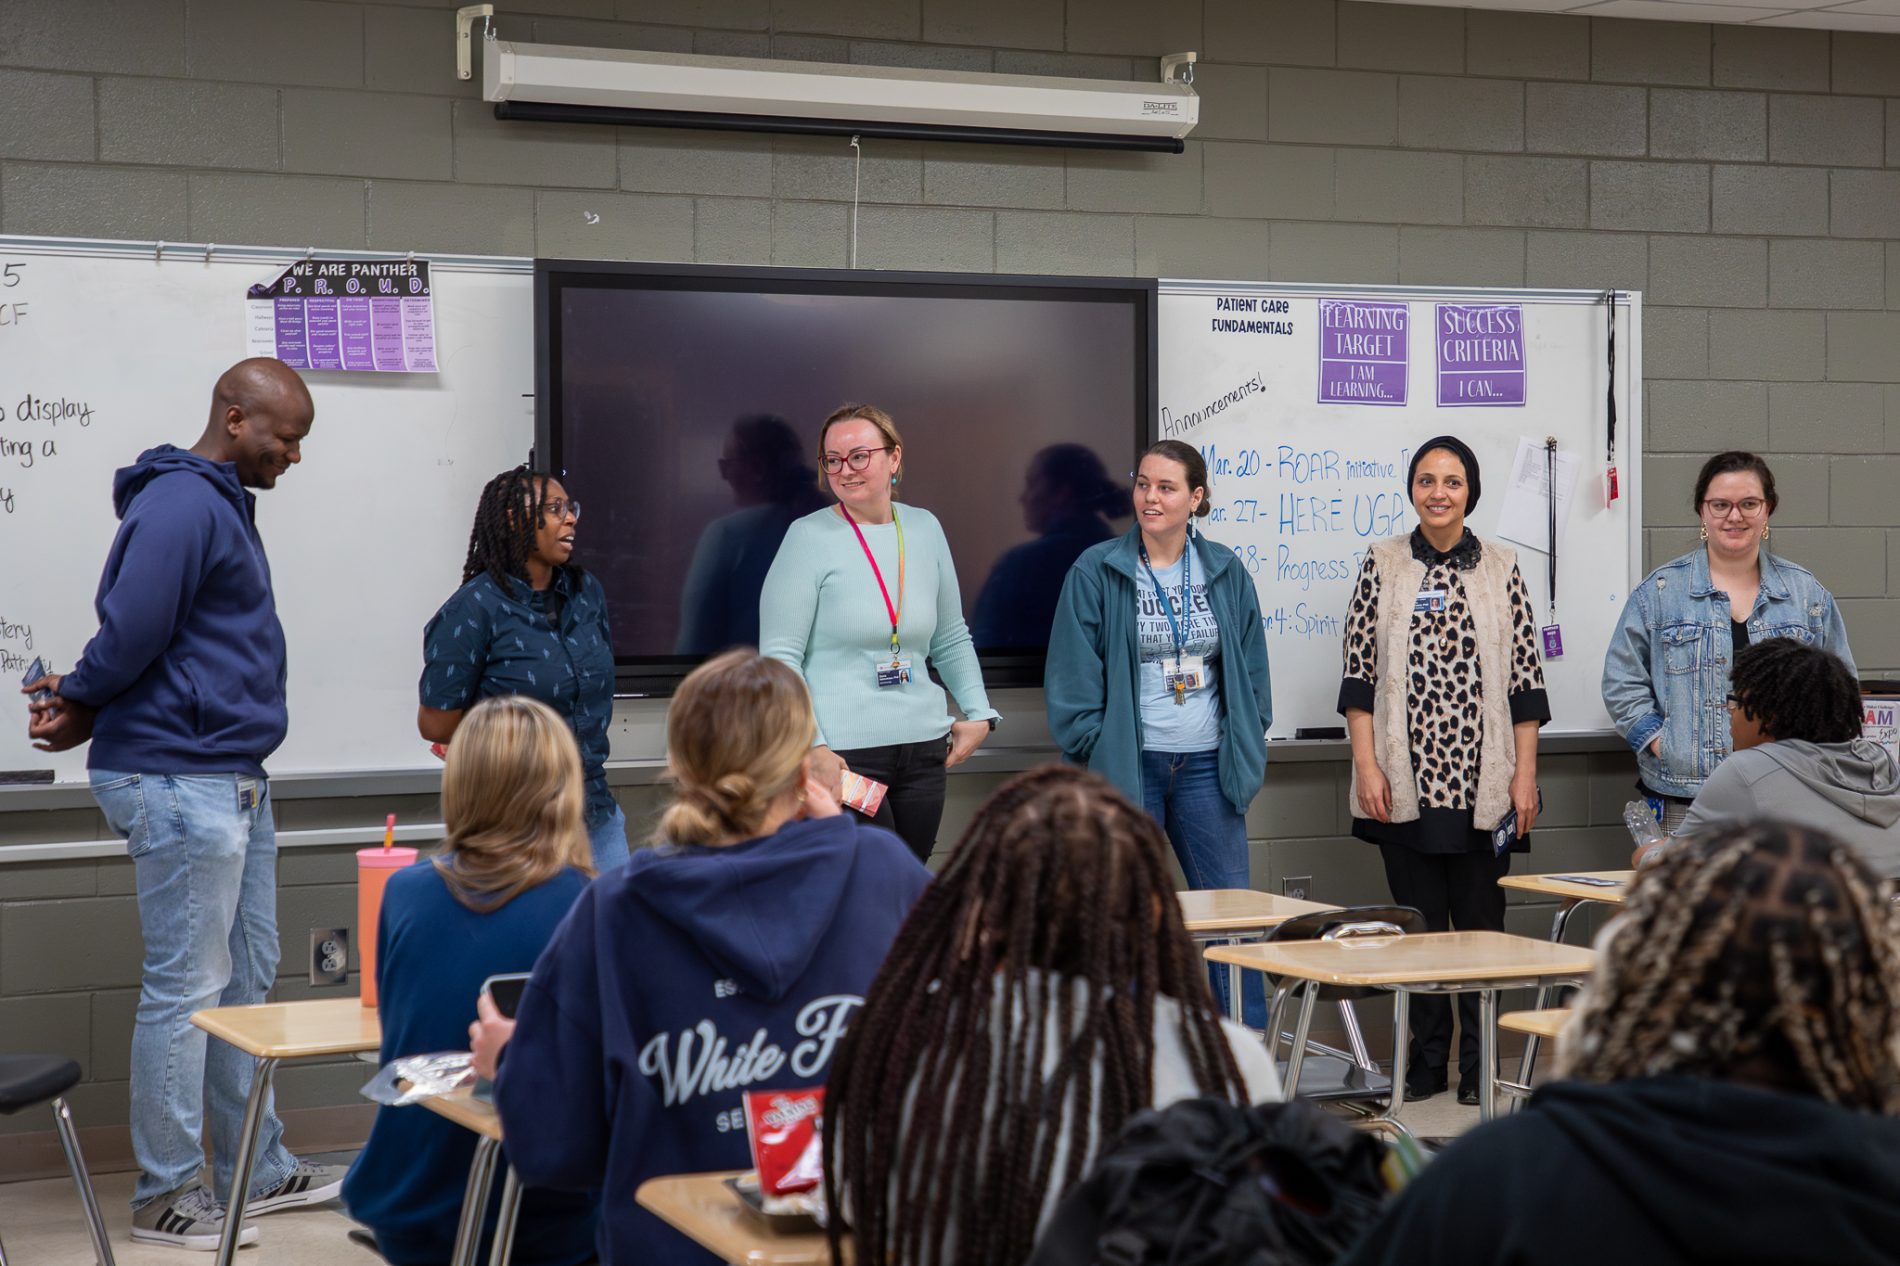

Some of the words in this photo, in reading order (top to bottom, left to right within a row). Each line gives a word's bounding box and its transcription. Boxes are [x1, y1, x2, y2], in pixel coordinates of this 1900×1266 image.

[3, 263, 27, 288] 5
[293, 264, 314, 276] WE
[319, 264, 346, 276] ARE
[352, 264, 418, 276] PANTHER
[1326, 306, 1404, 331] LEARNING
[1444, 311, 1515, 335] SUCCESS
[1334, 333, 1394, 356] TARGET
[1443, 339, 1520, 362] CRITERIA
[1357, 364, 1375, 381] AM
[1330, 381, 1393, 398] LEARNING...
[1468, 379, 1503, 398] CAN...
[16, 393, 95, 428] display
[1161, 371, 1266, 440] Announcements!
[42, 440, 57, 457] a
[1201, 444, 1232, 486] Mar.
[1236, 449, 1260, 478] 20
[1277, 445, 1340, 484] ROAR
[1346, 459, 1398, 481] initiative
[1279, 492, 1345, 535] HERE
[1353, 492, 1405, 536] UGA
[1277, 544, 1349, 591] Progress
[1150, 621, 1171, 632] TWO
[1295, 602, 1340, 640] Spirit
[0, 616, 33, 651] tery
[1141, 633, 1162, 644] THAT
[638, 1018, 787, 1108] White
